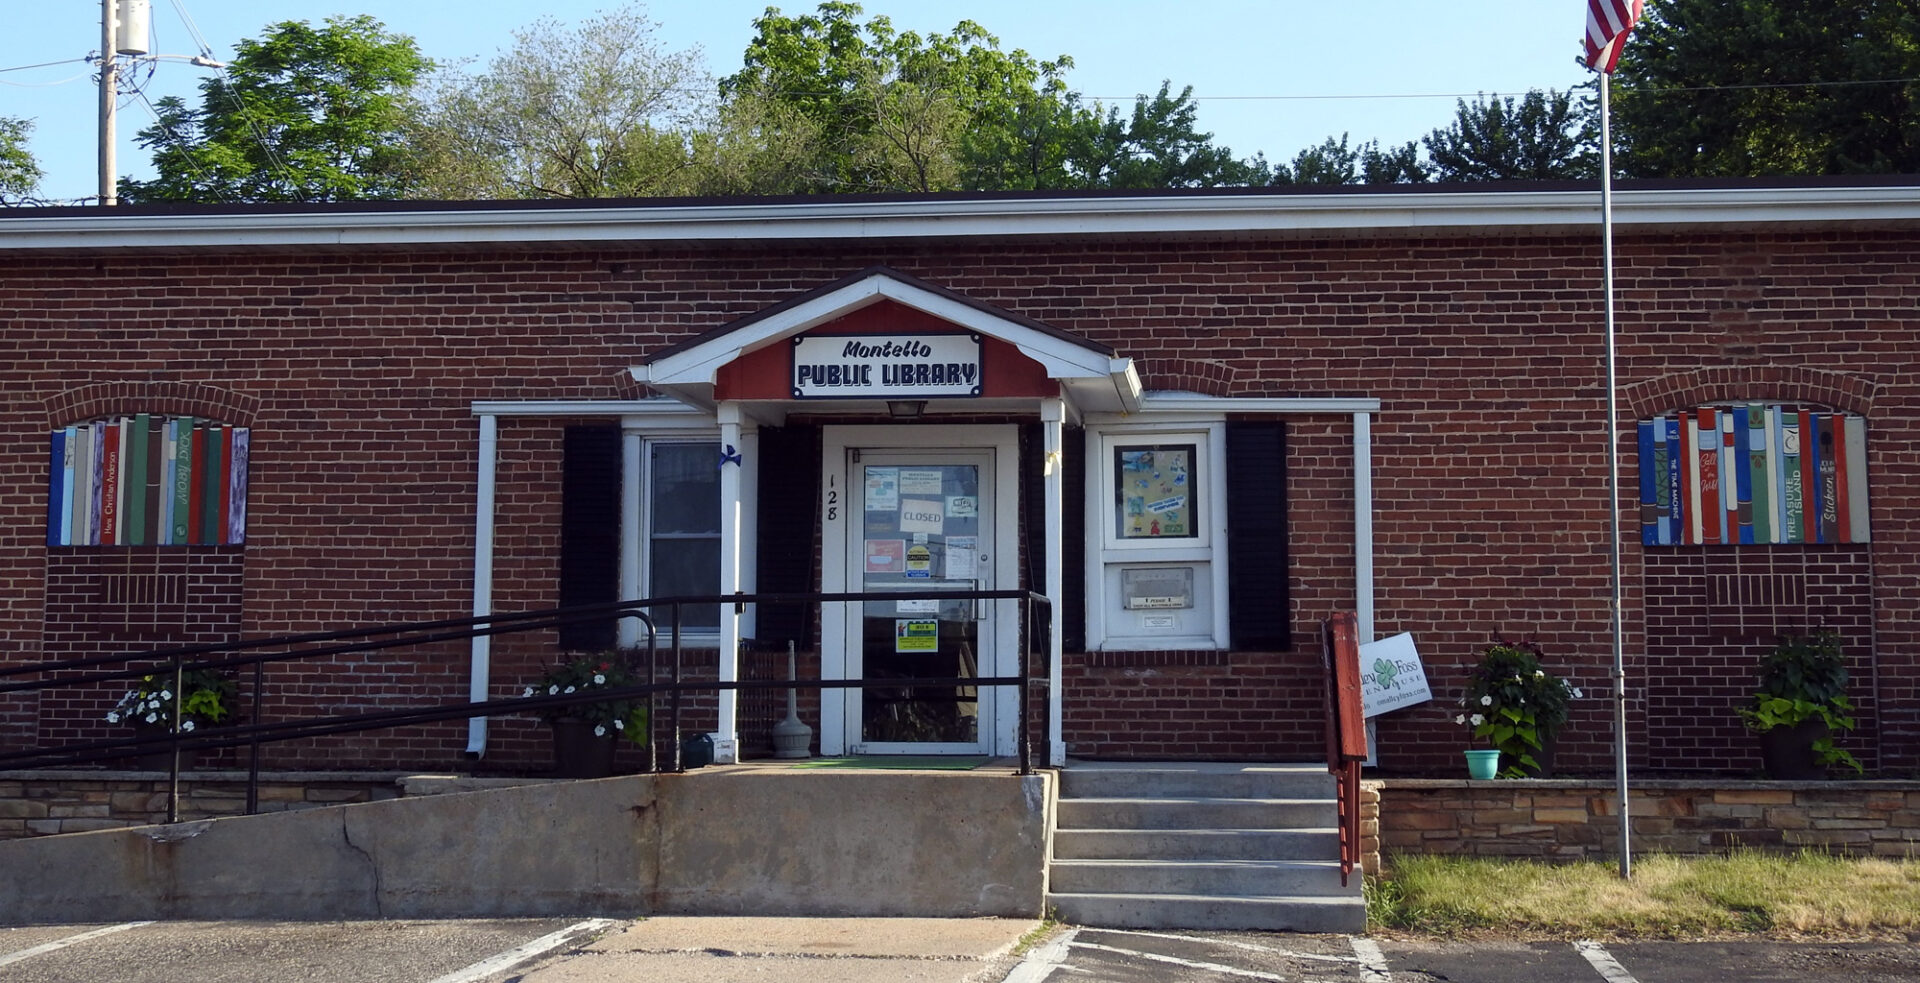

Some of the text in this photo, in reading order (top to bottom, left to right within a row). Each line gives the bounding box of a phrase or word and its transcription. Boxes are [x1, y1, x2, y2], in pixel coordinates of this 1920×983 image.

[842, 340, 932, 358] Montello
[797, 363, 977, 387] PUBLIC LIBRARY
[177, 431, 190, 504] MOBY DICK
[104, 484, 114, 515] Christian
[827, 474, 837, 521] 128
[1793, 470, 1803, 514] ISLAND
[903, 511, 942, 523] CLOSED
[1785, 477, 1797, 539] TREASURE
[104, 518, 112, 535] Hans
[1394, 659, 1418, 675] Foss
